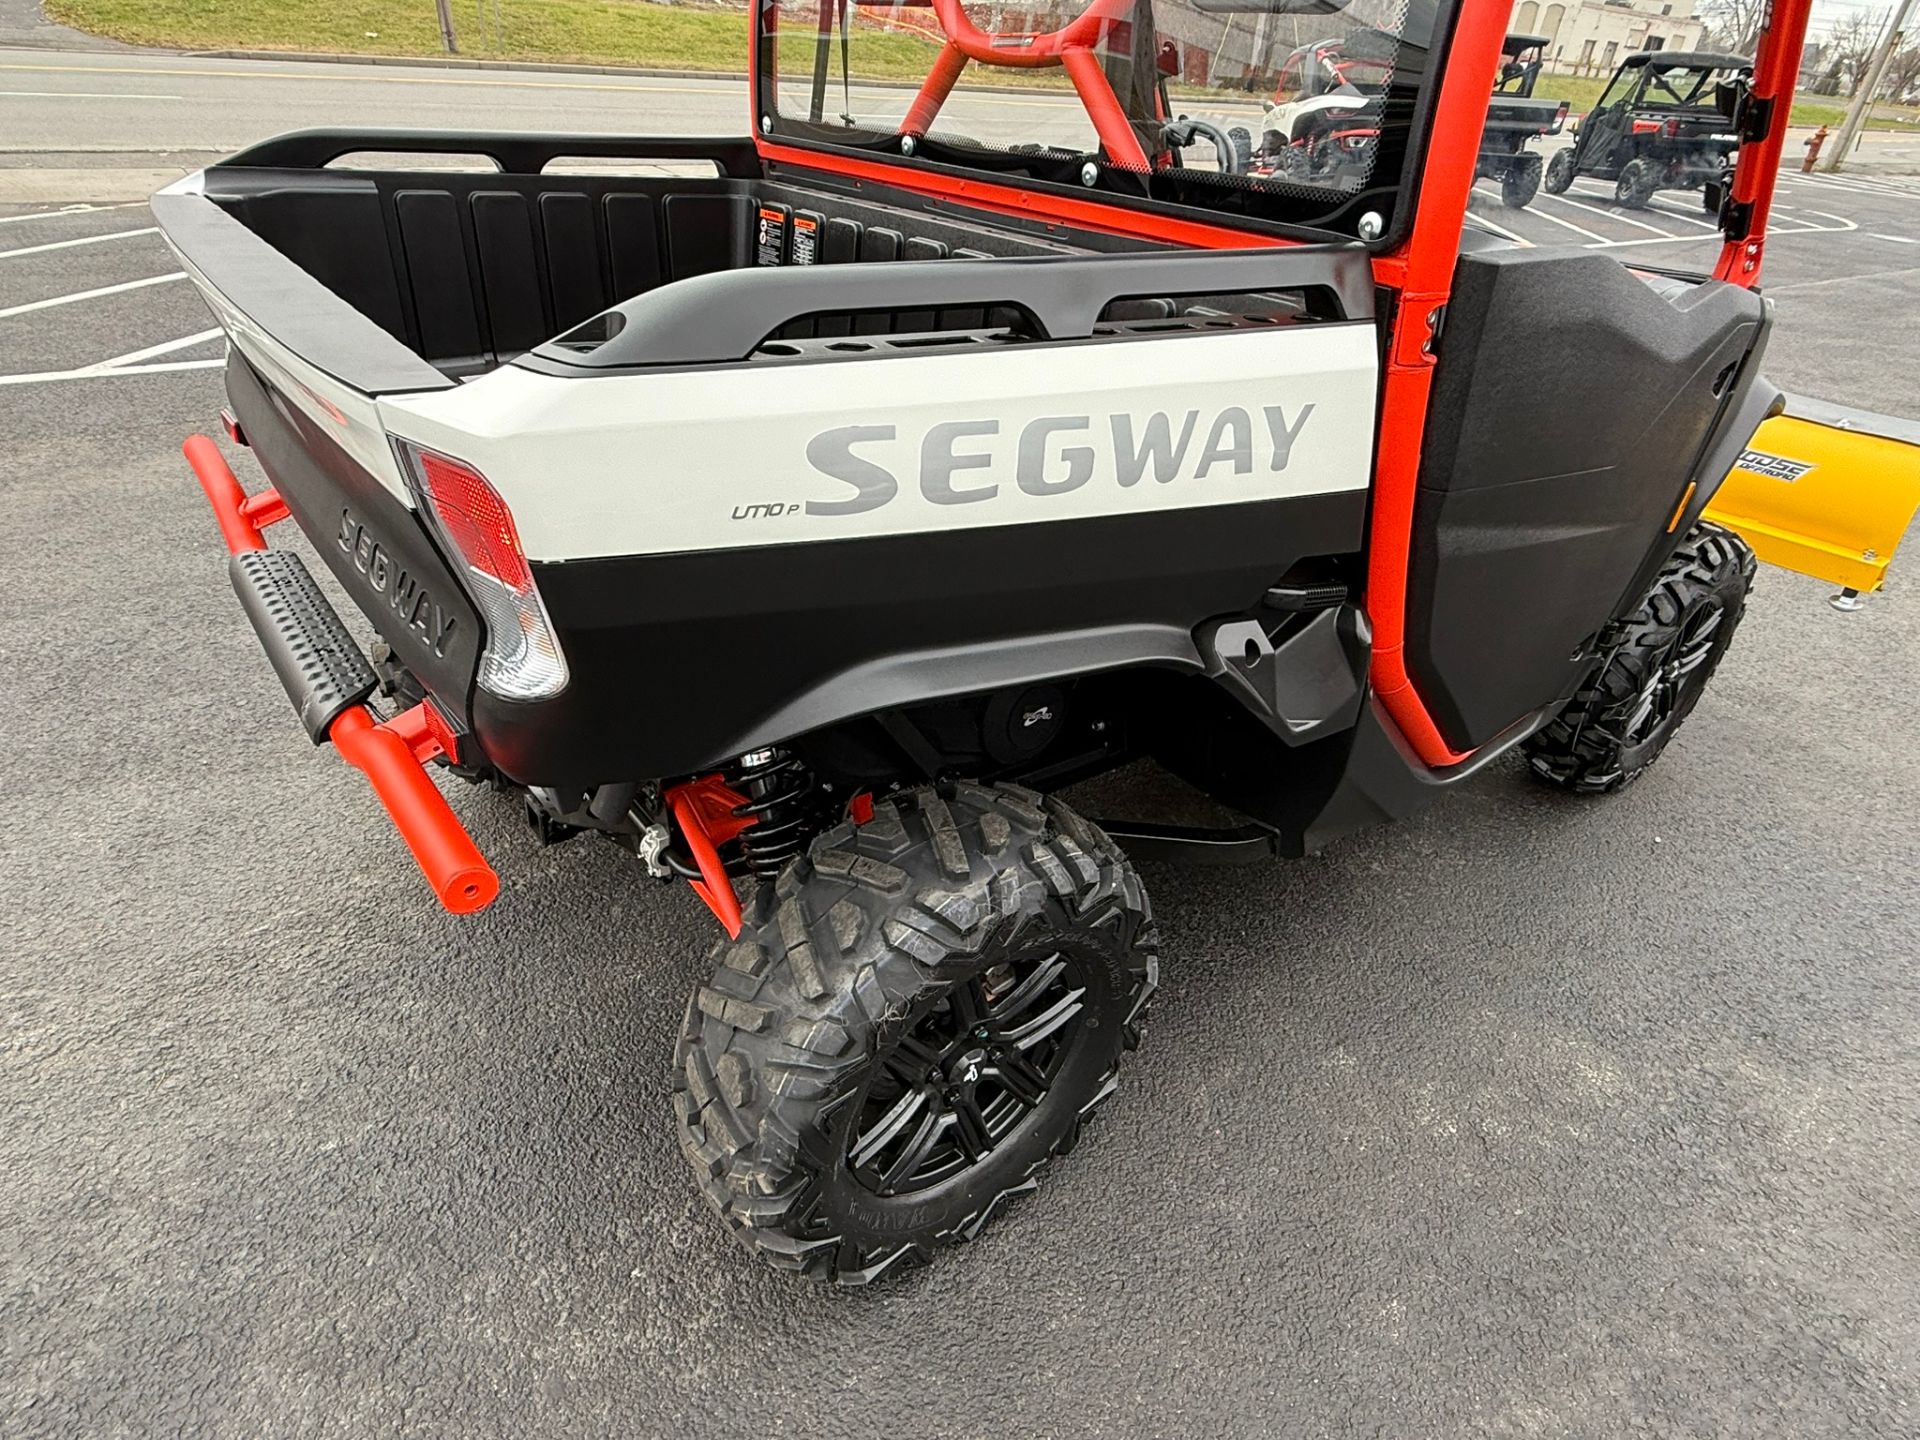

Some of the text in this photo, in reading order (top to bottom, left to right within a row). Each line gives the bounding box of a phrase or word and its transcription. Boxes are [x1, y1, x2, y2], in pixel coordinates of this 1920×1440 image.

[787, 504, 800, 515] P
[805, 404, 1316, 516] SEGWAY
[338, 508, 456, 658] SEGWAY
